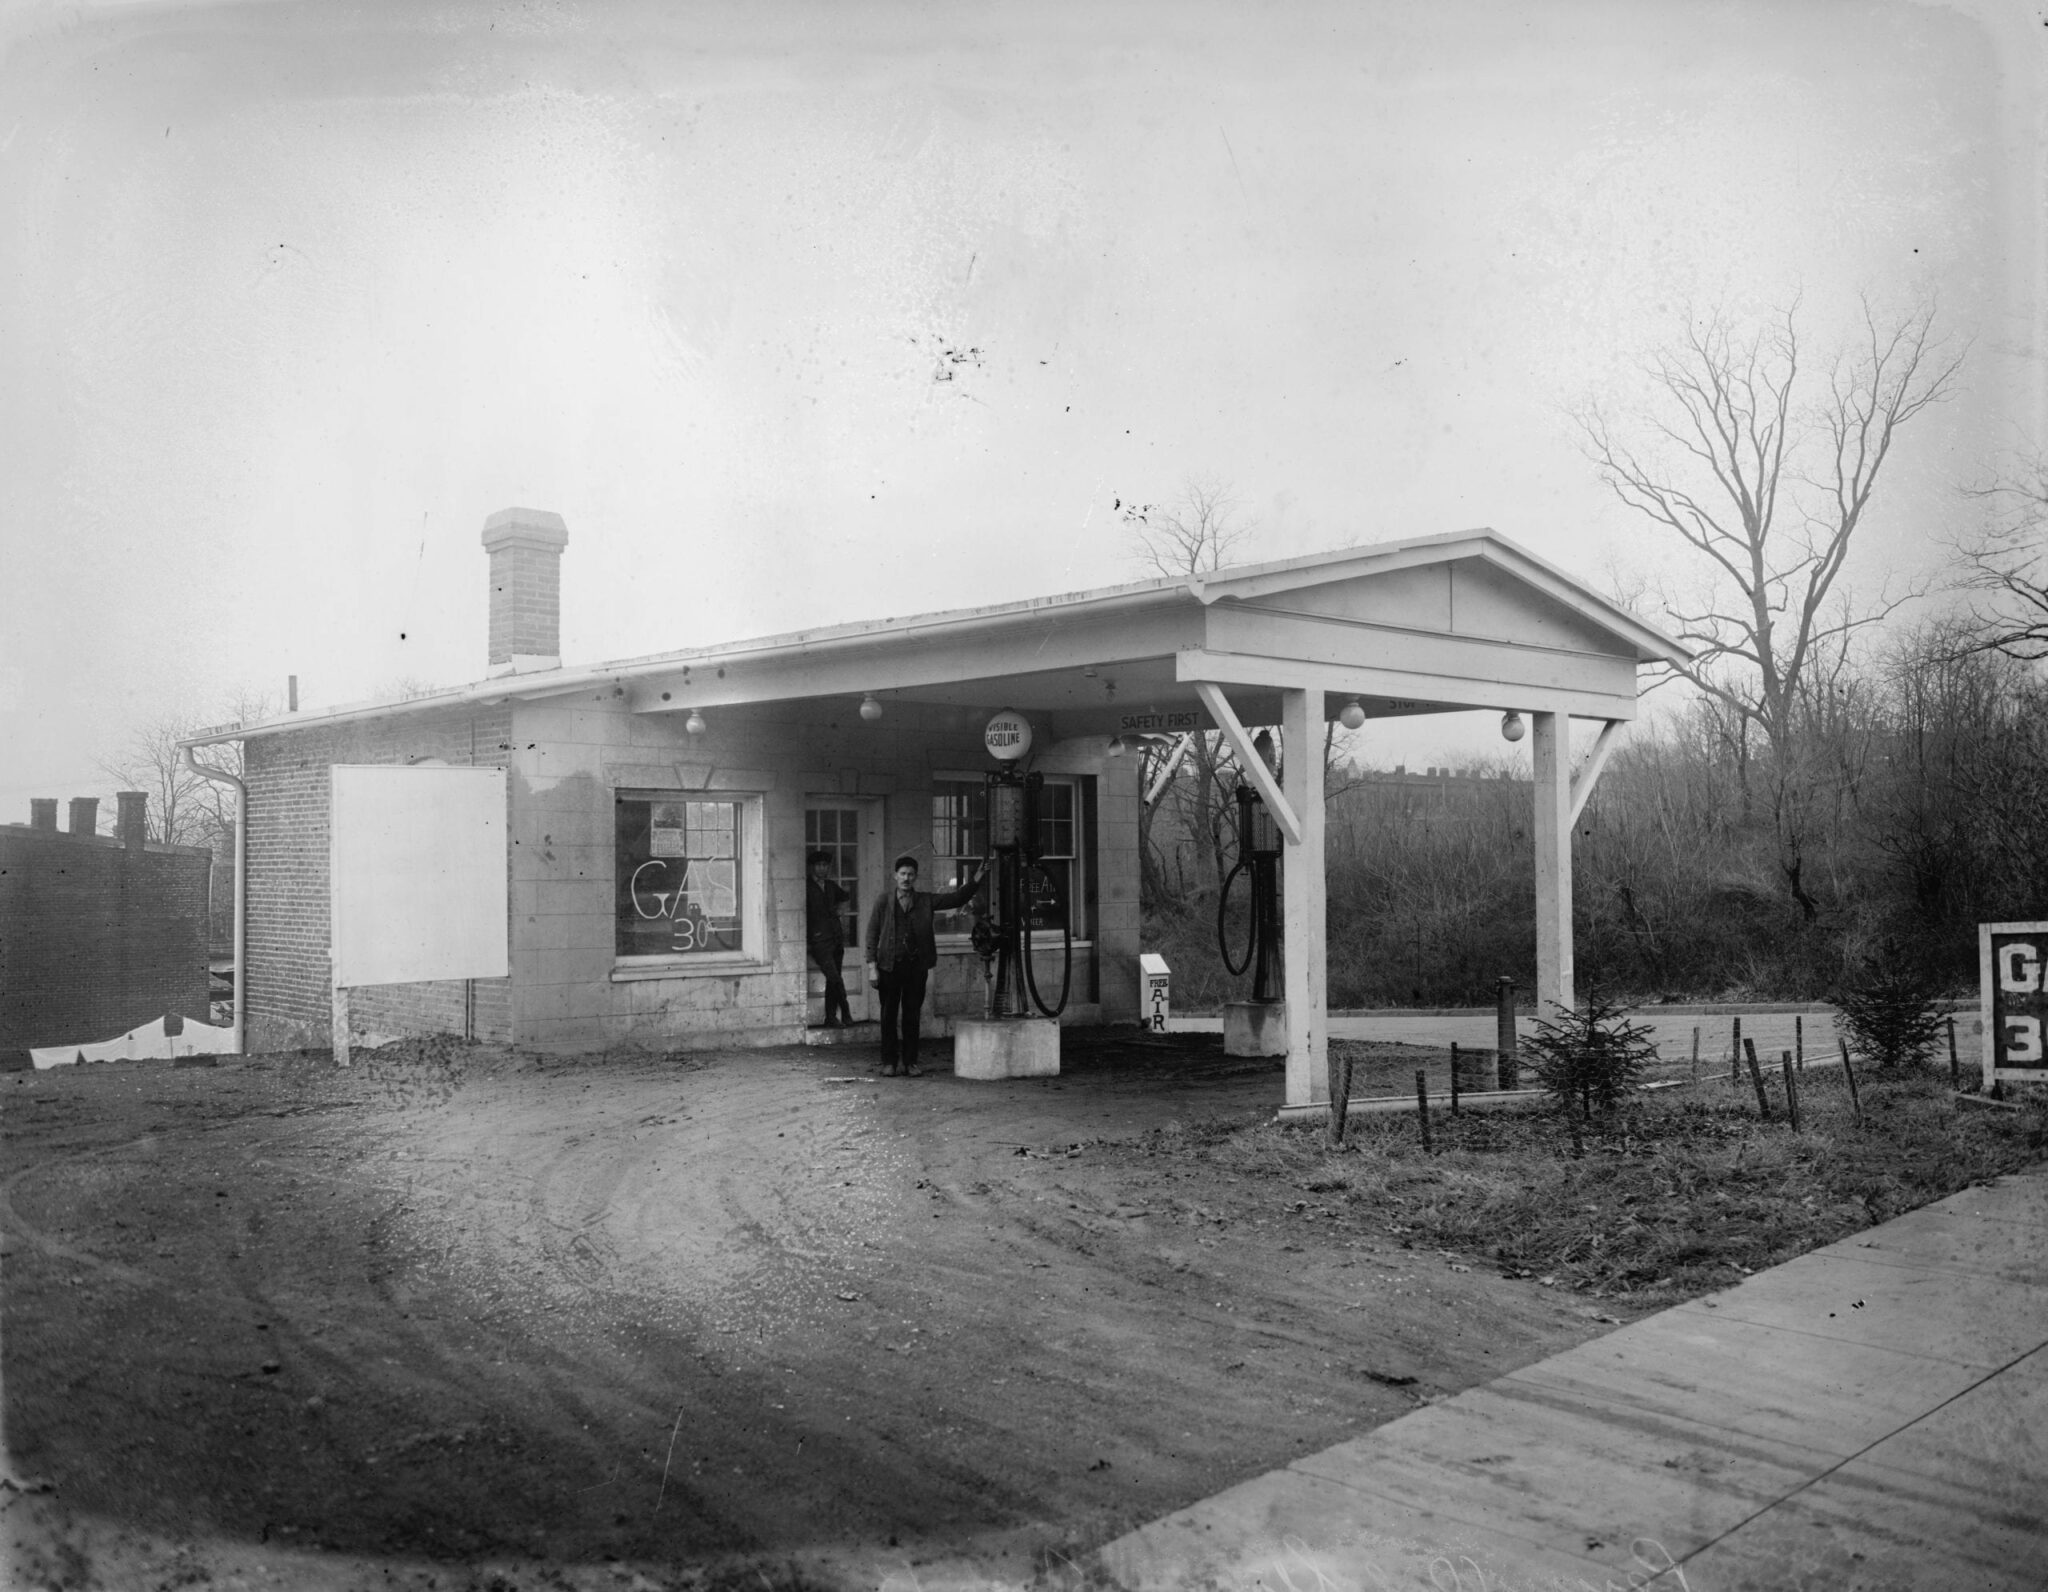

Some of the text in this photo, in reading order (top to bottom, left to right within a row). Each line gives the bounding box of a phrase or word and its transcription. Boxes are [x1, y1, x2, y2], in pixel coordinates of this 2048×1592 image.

[987, 721, 1019, 732] VISIBLE
[1121, 712, 1200, 730] SAFETY FIRST
[986, 732, 1020, 747] GASOLINE
[631, 856, 737, 921] GAS
[671, 917, 708, 950] 30
[1999, 943, 2048, 993] G
[1149, 978, 1168, 988] FREE
[1150, 988, 1165, 1031] AIR
